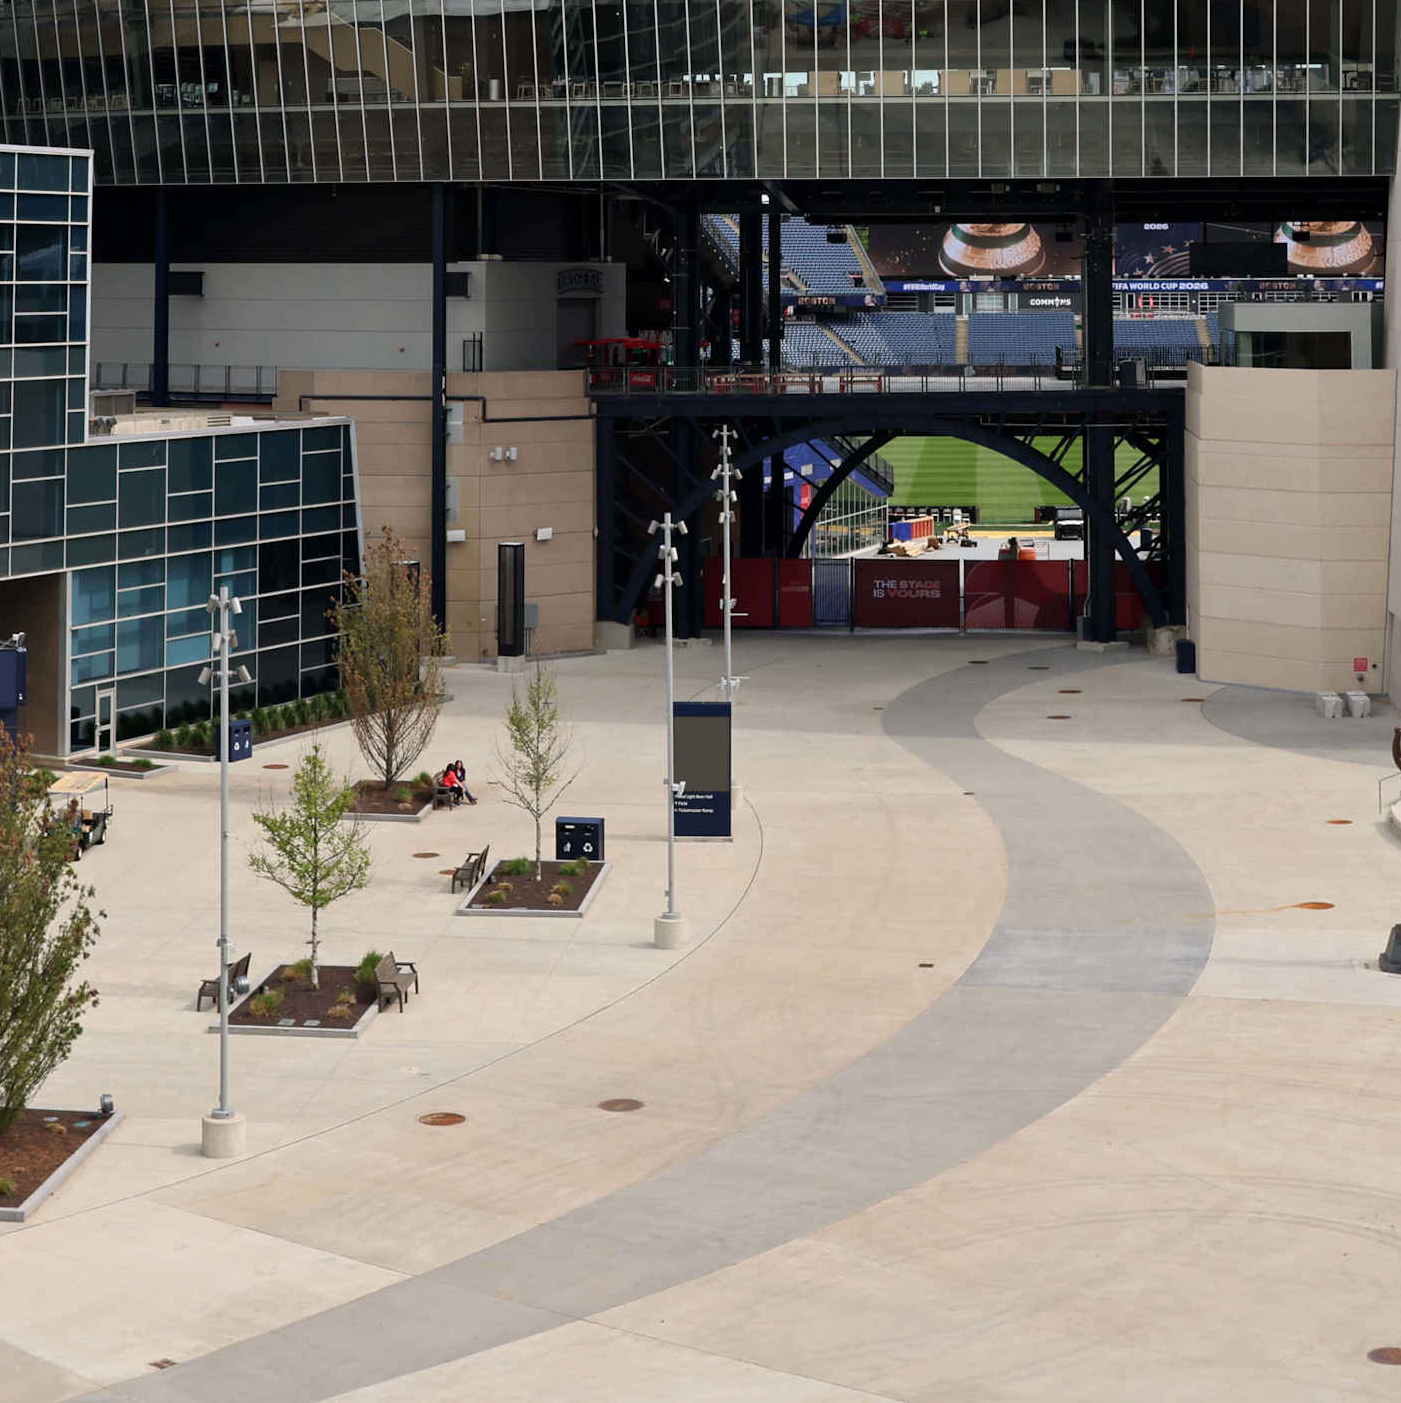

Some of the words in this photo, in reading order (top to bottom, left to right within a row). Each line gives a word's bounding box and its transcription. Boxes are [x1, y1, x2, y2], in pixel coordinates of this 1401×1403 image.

[1129, 282, 1160, 290] WORLD
[1161, 282, 1178, 290] CUP
[1179, 282, 1209, 290] 2026
[873, 580, 897, 589] THE
[899, 580, 941, 589] STAGE
[873, 589, 885, 598] IS
[888, 589, 942, 598] YOURS
